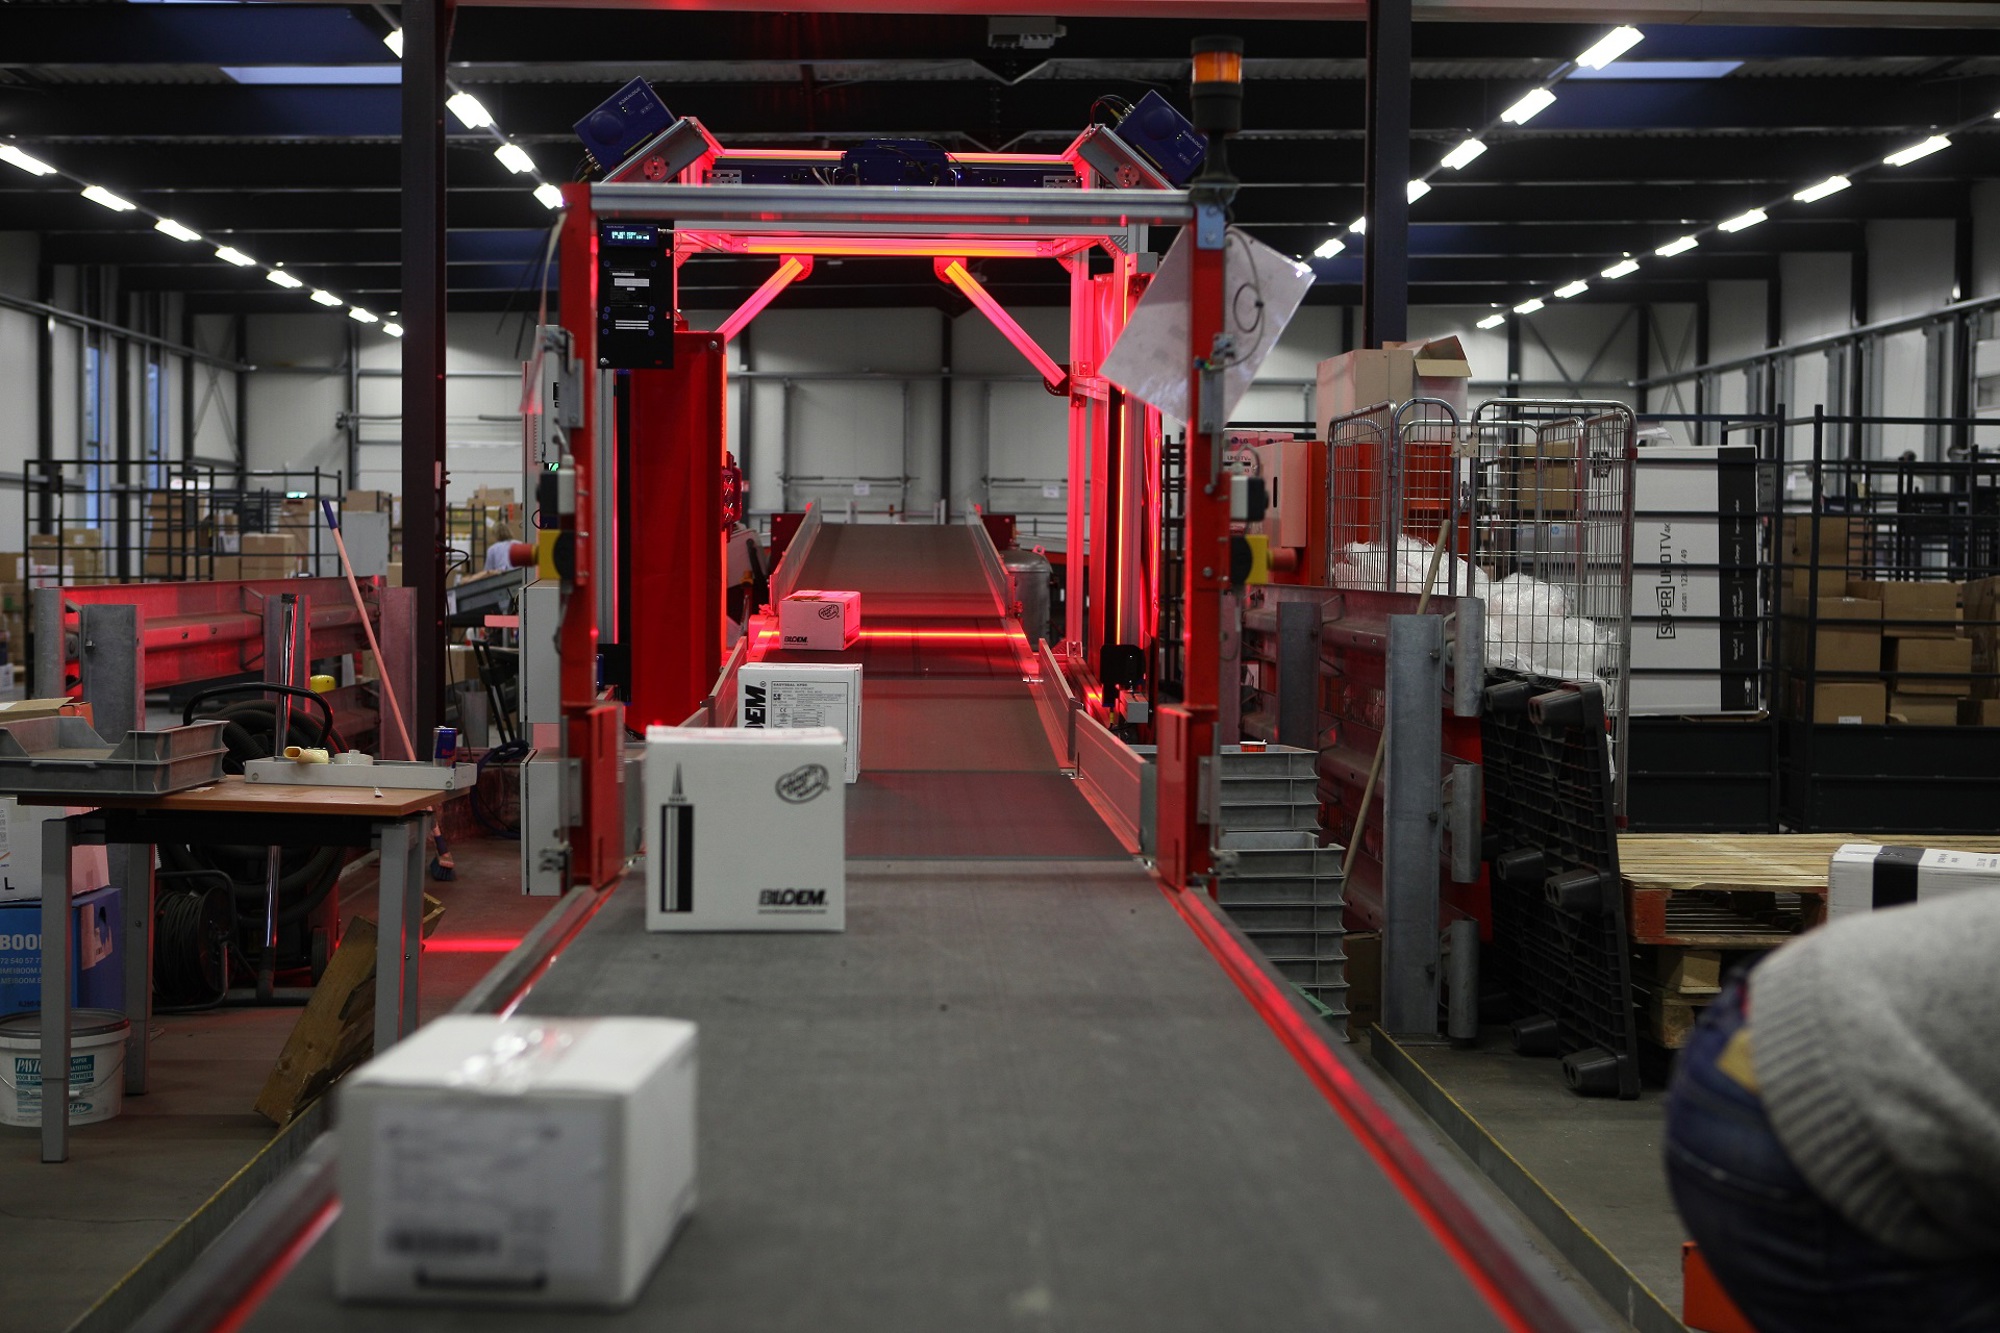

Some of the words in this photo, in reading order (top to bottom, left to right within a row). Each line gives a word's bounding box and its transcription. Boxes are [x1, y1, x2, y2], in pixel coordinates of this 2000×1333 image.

[1660, 590, 1672, 635] SUPER
[745, 685, 766, 728] EM
[4, 877, 15, 890] L
[758, 889, 827, 905] BLOEM
[0, 933, 42, 951] BOO
